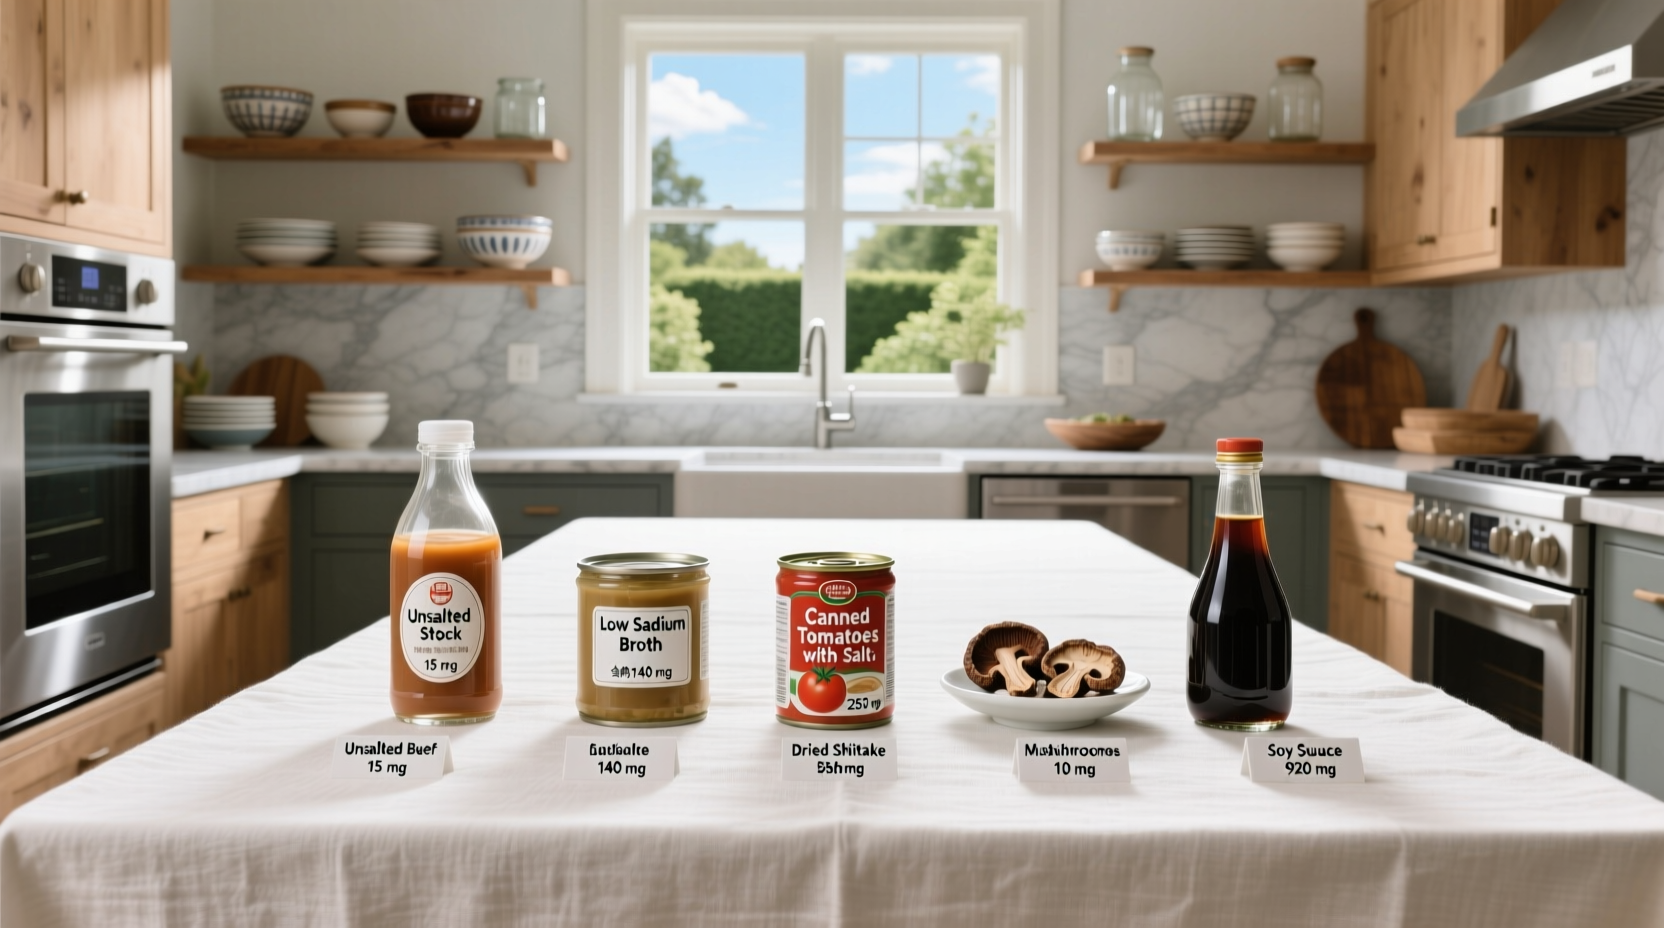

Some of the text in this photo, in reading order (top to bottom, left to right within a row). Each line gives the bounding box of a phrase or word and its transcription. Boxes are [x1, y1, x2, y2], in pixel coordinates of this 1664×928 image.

[408, 607, 471, 623] Unsalted
[805, 607, 870, 625] Canned
[600, 616, 629, 632] Low
[420, 625, 462, 641] Stock
[797, 626, 879, 645] Tomatoes
[619, 636, 662, 652] Broth
[424, 658, 438, 671] 15
[655, 668, 673, 680] mg
[345, 741, 403, 755] Unsalted
[792, 742, 829, 757] Dried
[1267, 743, 1293, 760] Soy
[367, 760, 407, 777] 15 mg
[598, 760, 646, 778] 140 mg
[1054, 761, 1096, 778] 10 mg
[1285, 761, 1336, 778] 920 mg
